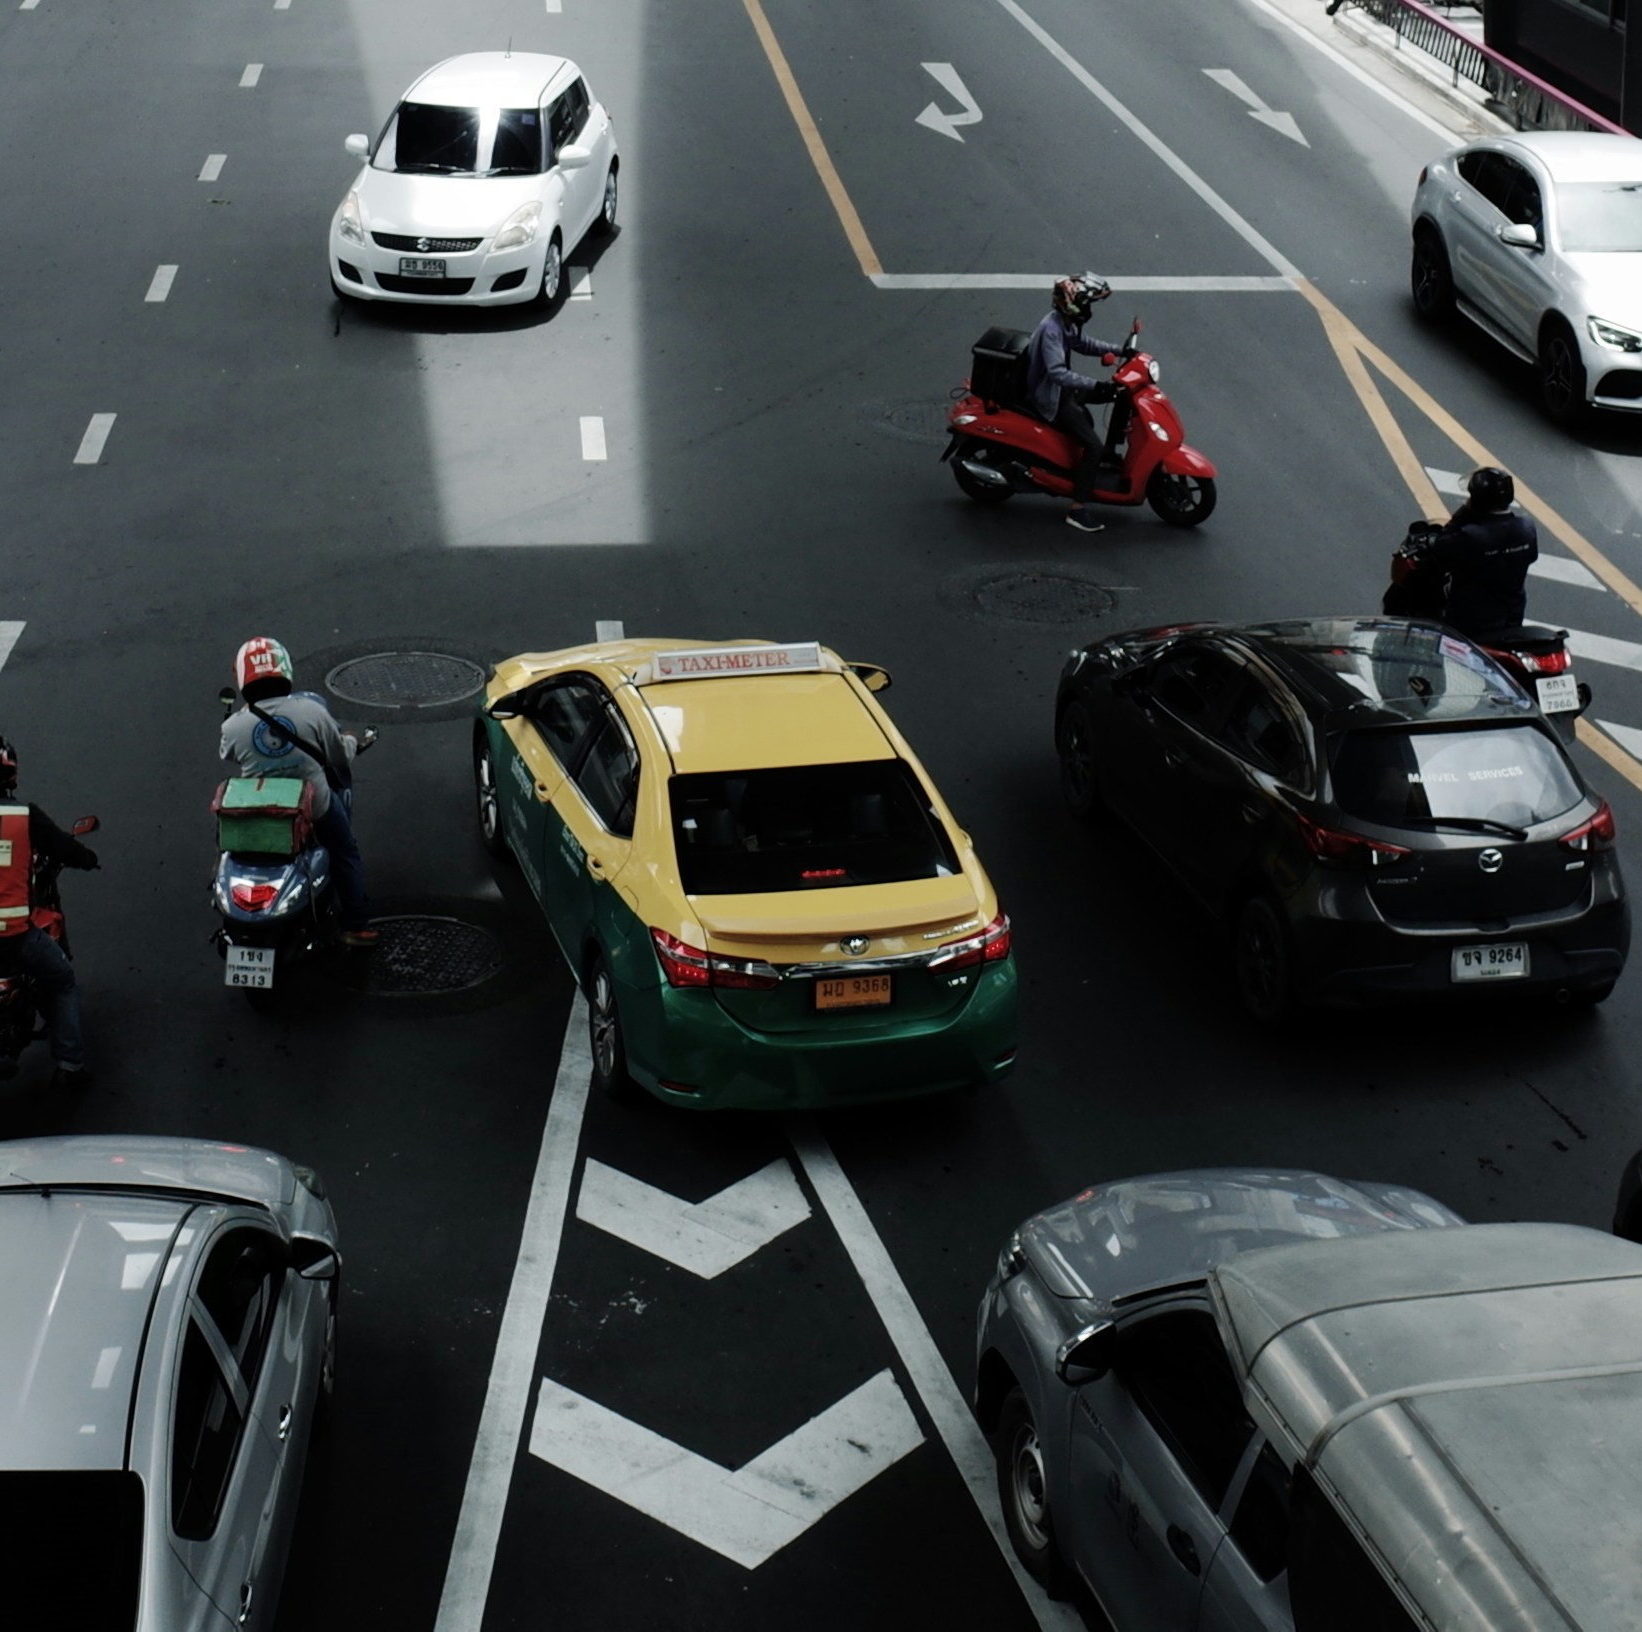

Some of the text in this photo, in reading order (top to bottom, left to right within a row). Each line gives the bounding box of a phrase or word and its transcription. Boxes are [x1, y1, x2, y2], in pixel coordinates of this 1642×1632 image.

[678, 652, 791, 672] TAXI-METER
[1407, 766, 1524, 783] MARVEL SERVICES
[1489, 947, 1522, 964] 9264
[232, 973, 265, 986] 8313
[853, 978, 889, 994] 9368
